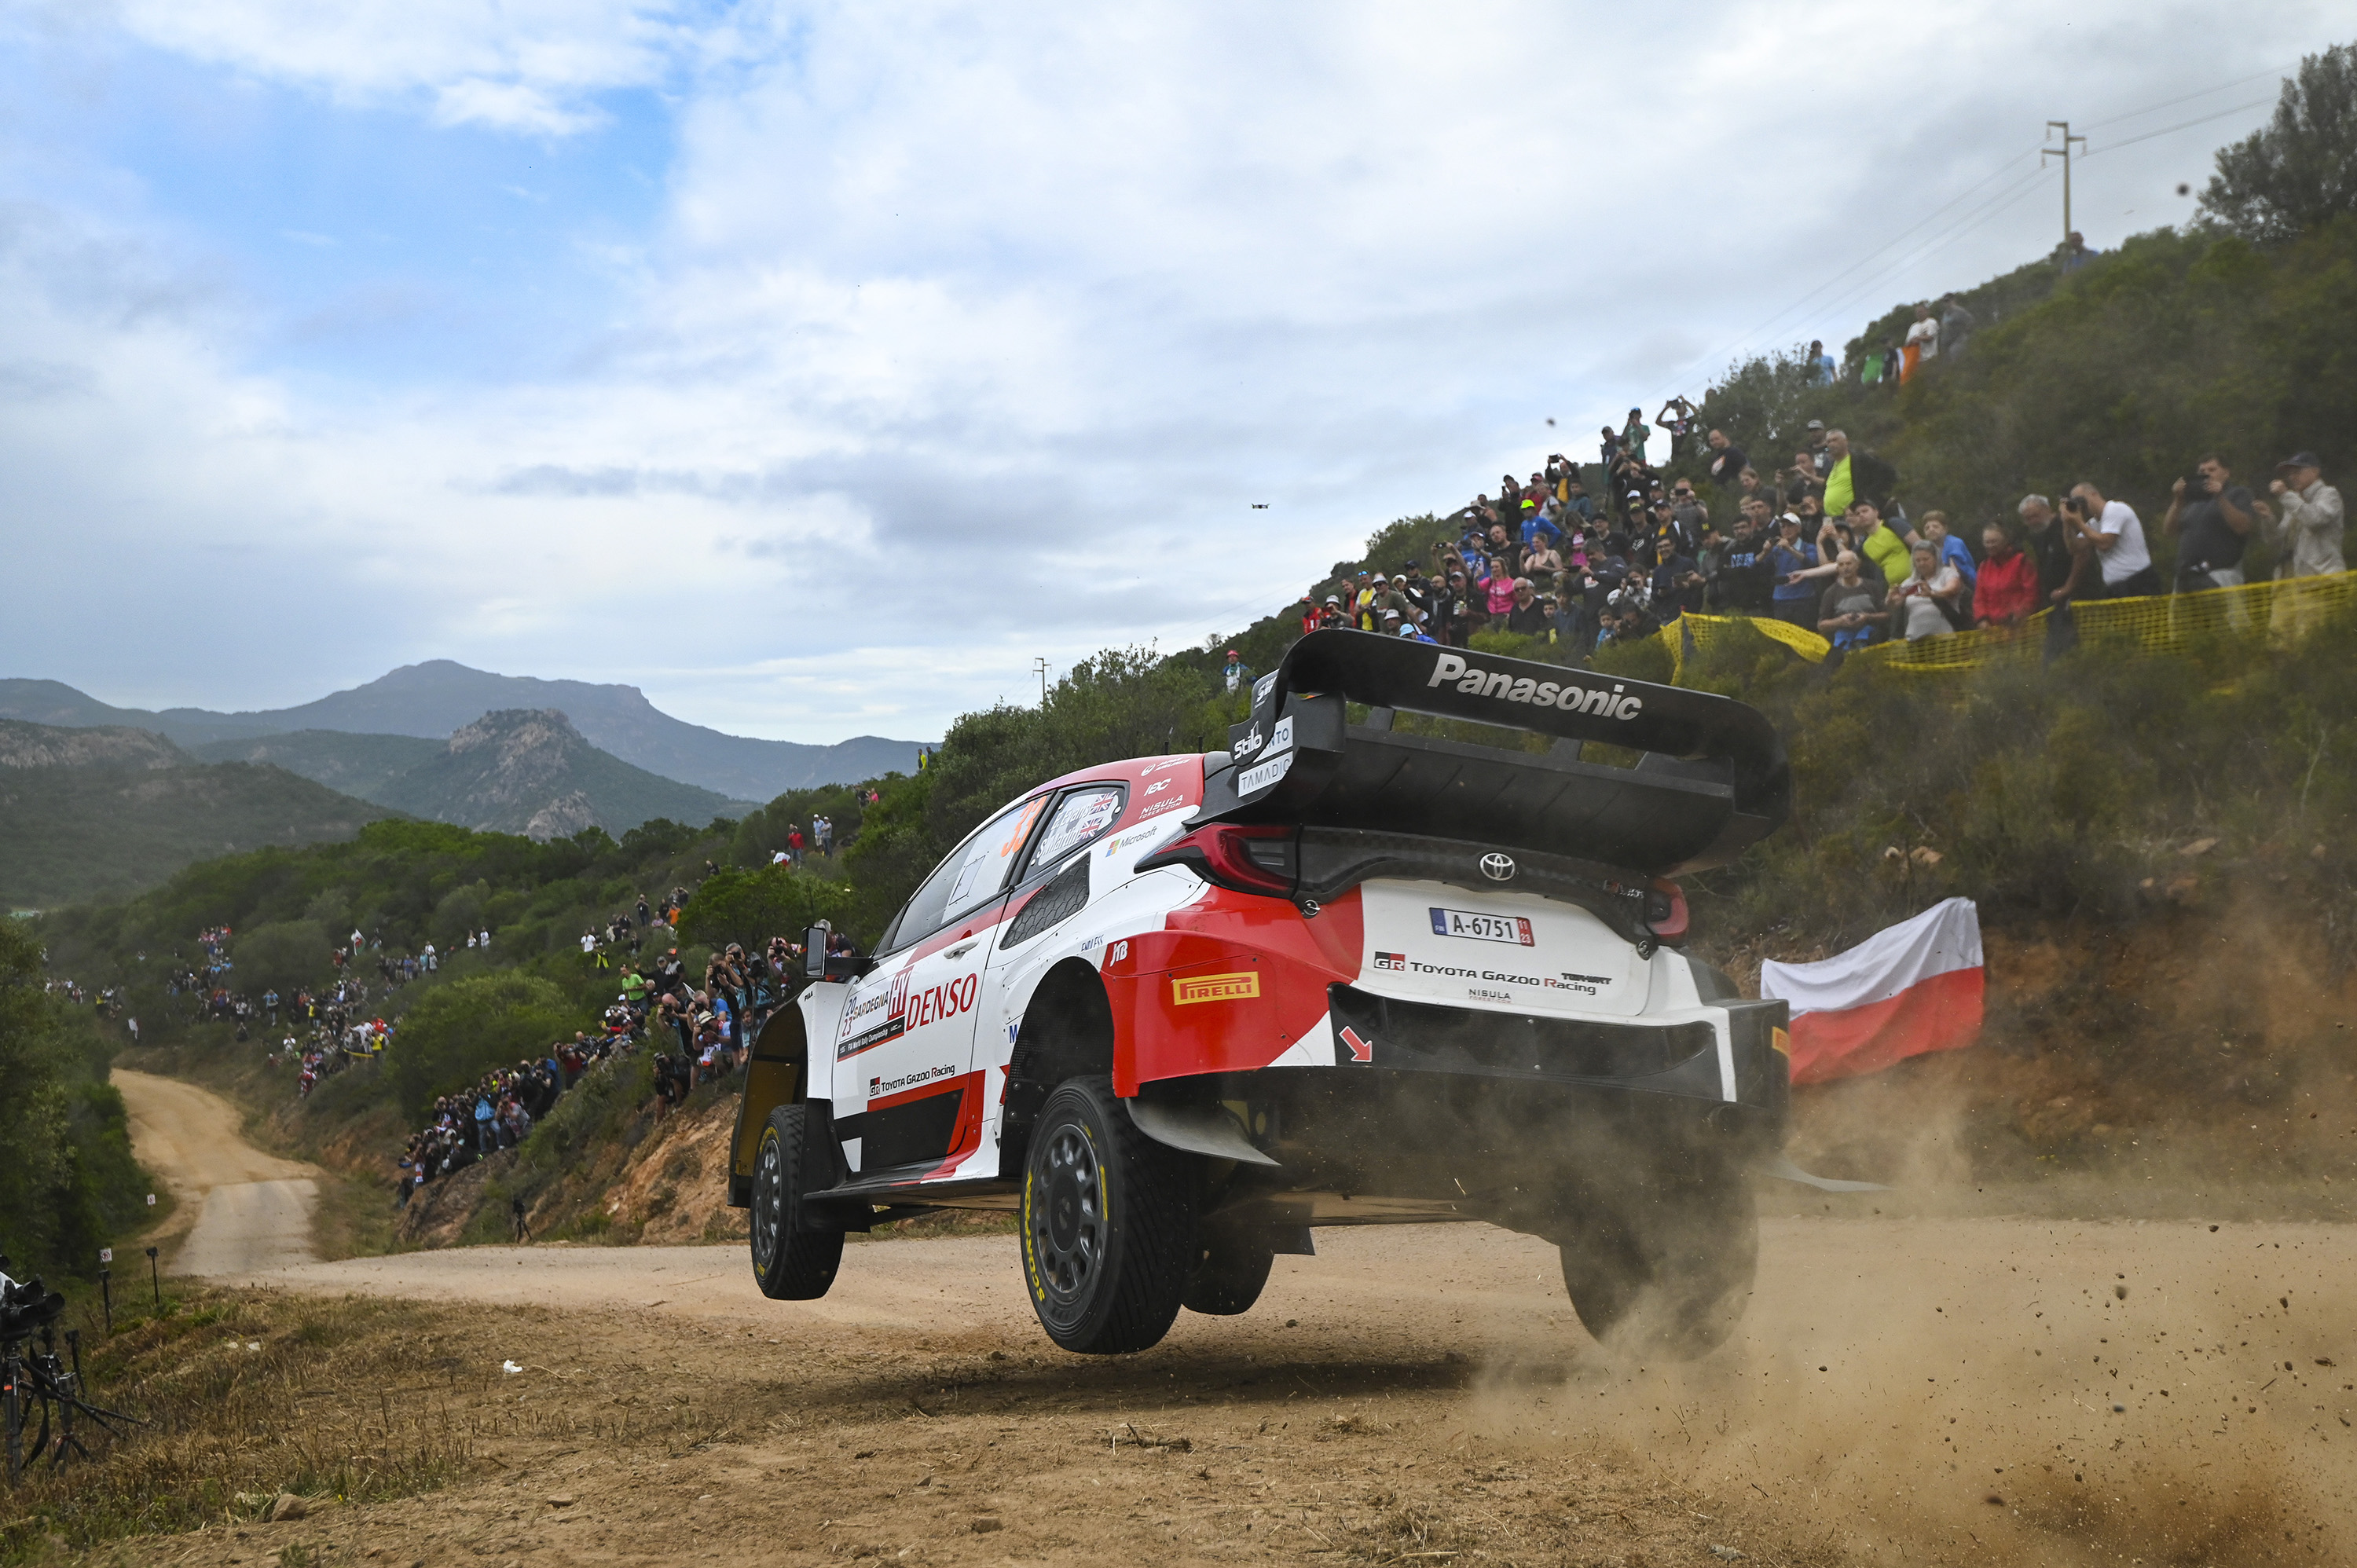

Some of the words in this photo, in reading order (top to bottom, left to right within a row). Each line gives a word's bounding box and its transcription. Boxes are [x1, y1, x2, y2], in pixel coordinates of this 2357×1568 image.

[1427, 653, 1643, 720] Panasonic
[1234, 720, 1263, 760] Stilo
[1241, 758, 1291, 789] TAMADIC
[1141, 794, 1183, 815] NISULA
[1000, 795, 1047, 858] 33
[1119, 826, 1157, 849] Microsoft
[1453, 914, 1513, 939] A-6751
[1518, 920, 1527, 930] 11
[1520, 933, 1531, 943] 23
[1180, 976, 1252, 1000] PIRELLI
[1375, 958, 1404, 970] GR
[1410, 962, 1477, 979] TOYOTA
[1482, 970, 1540, 986] GAZOO
[1544, 978, 1596, 995] Racing
[853, 991, 889, 1020] SARDEGNA
[906, 973, 977, 1031] DENSO
[1468, 988, 1511, 999] NISULA
[846, 996, 856, 1017] 20
[842, 1016, 852, 1037] 23
[870, 1084, 880, 1097] GR
[881, 1078, 905, 1092] TOYOTA
[906, 1071, 930, 1085] GAZOO
[931, 1064, 955, 1079] Racing
